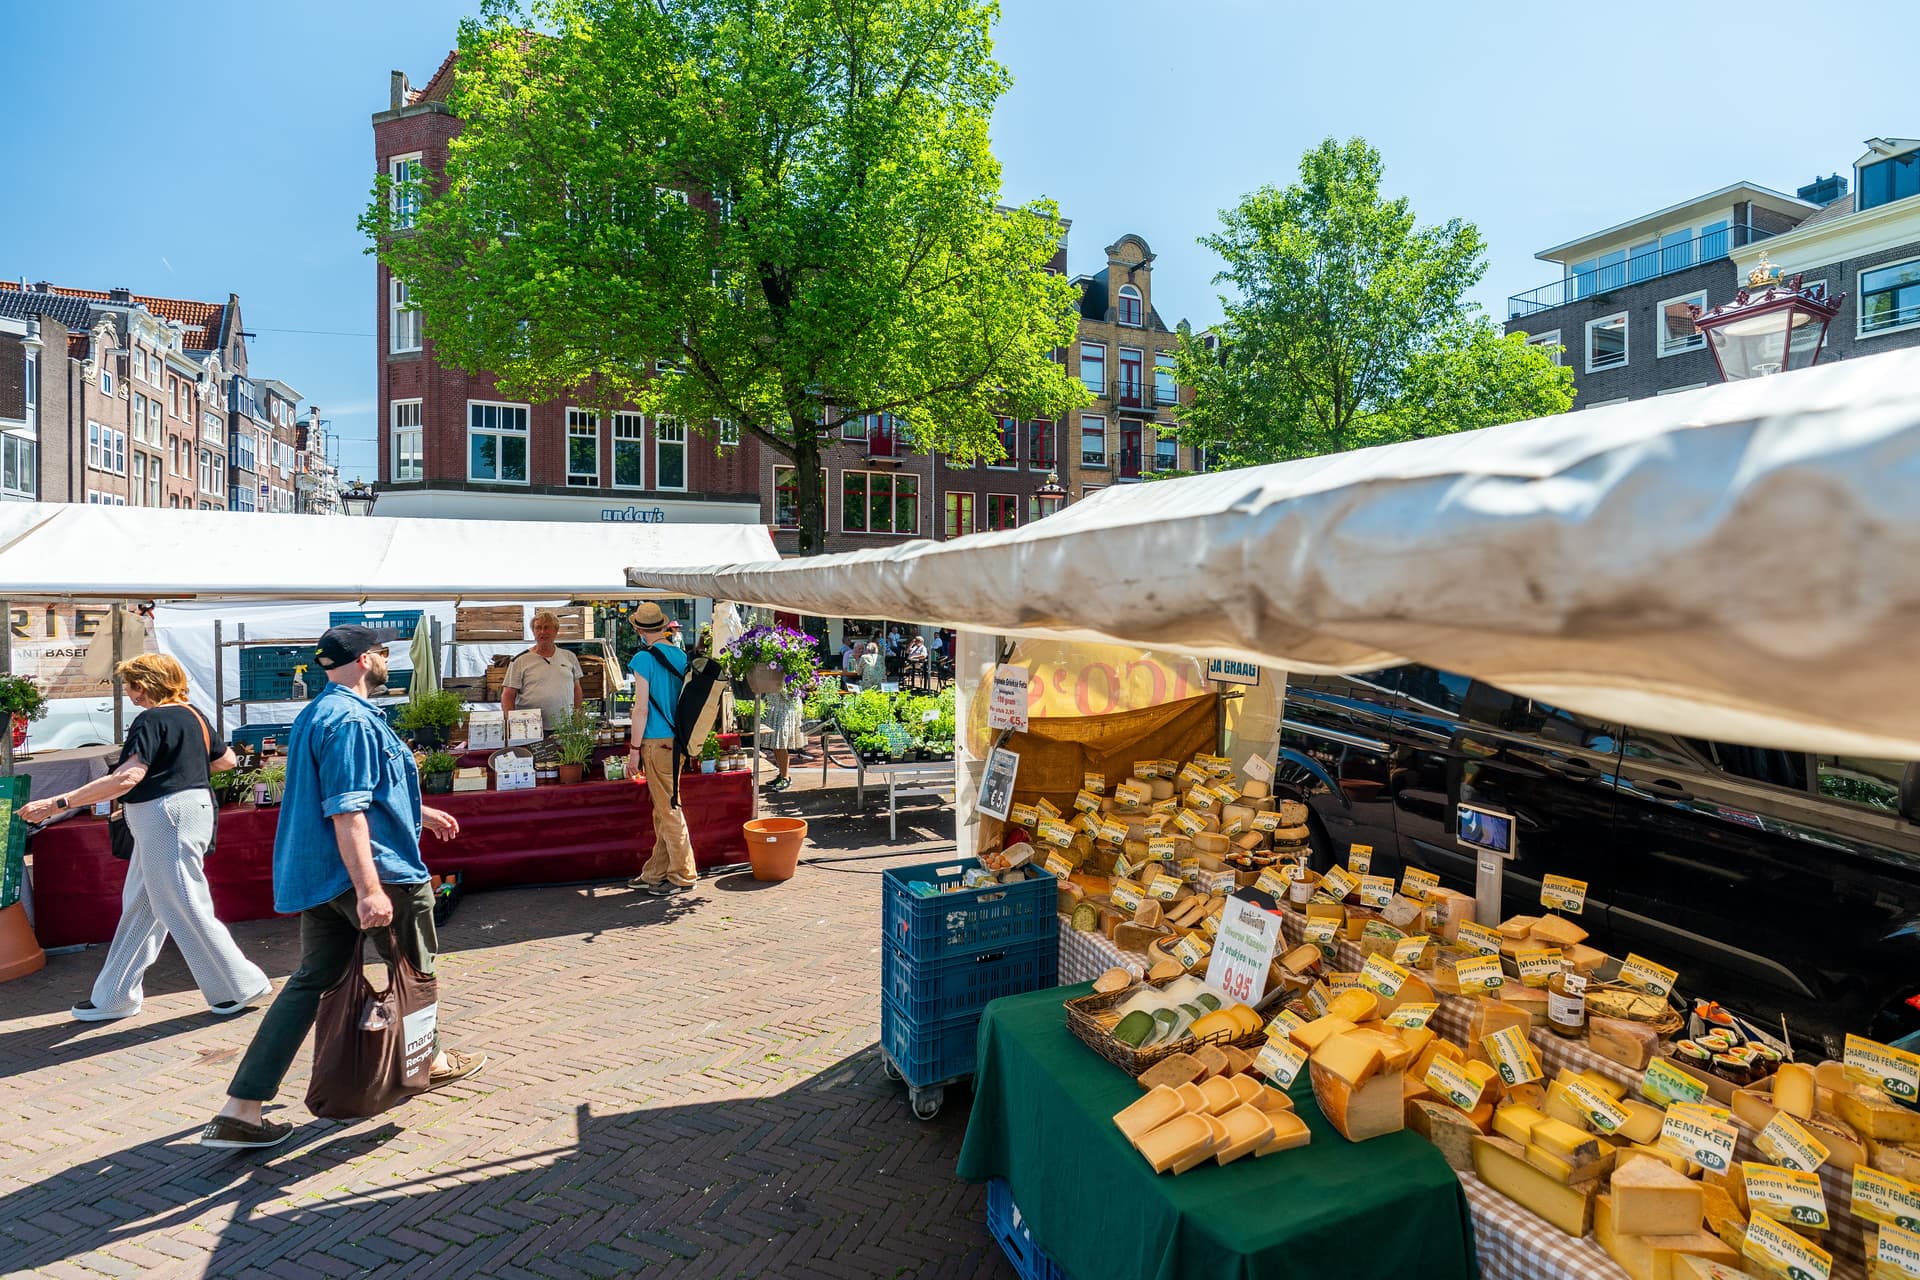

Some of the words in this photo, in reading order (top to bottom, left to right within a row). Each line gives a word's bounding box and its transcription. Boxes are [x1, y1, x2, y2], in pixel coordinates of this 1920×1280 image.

[1224, 660, 1256, 677] GRAAG
[1519, 957, 1561, 969] Morbie
[1222, 967, 1252, 1000] 9,95
[1381, 969, 1403, 986] JERSEY
[1644, 967, 1673, 986] STILTON
[1887, 1079, 1910, 1095] 2,40
[1665, 1117, 1732, 1151] REMEKER
[1698, 1150, 1720, 1167] 3,89
[1746, 1177, 1783, 1189] Boeren
[1796, 1208, 1820, 1223] 2,40
[1749, 1223, 1780, 1243] BOEREN
[1781, 1239, 1807, 1261] GATEN
[1808, 1255, 1829, 1277] KAAS
[1879, 1238, 1920, 1261] Boeren
